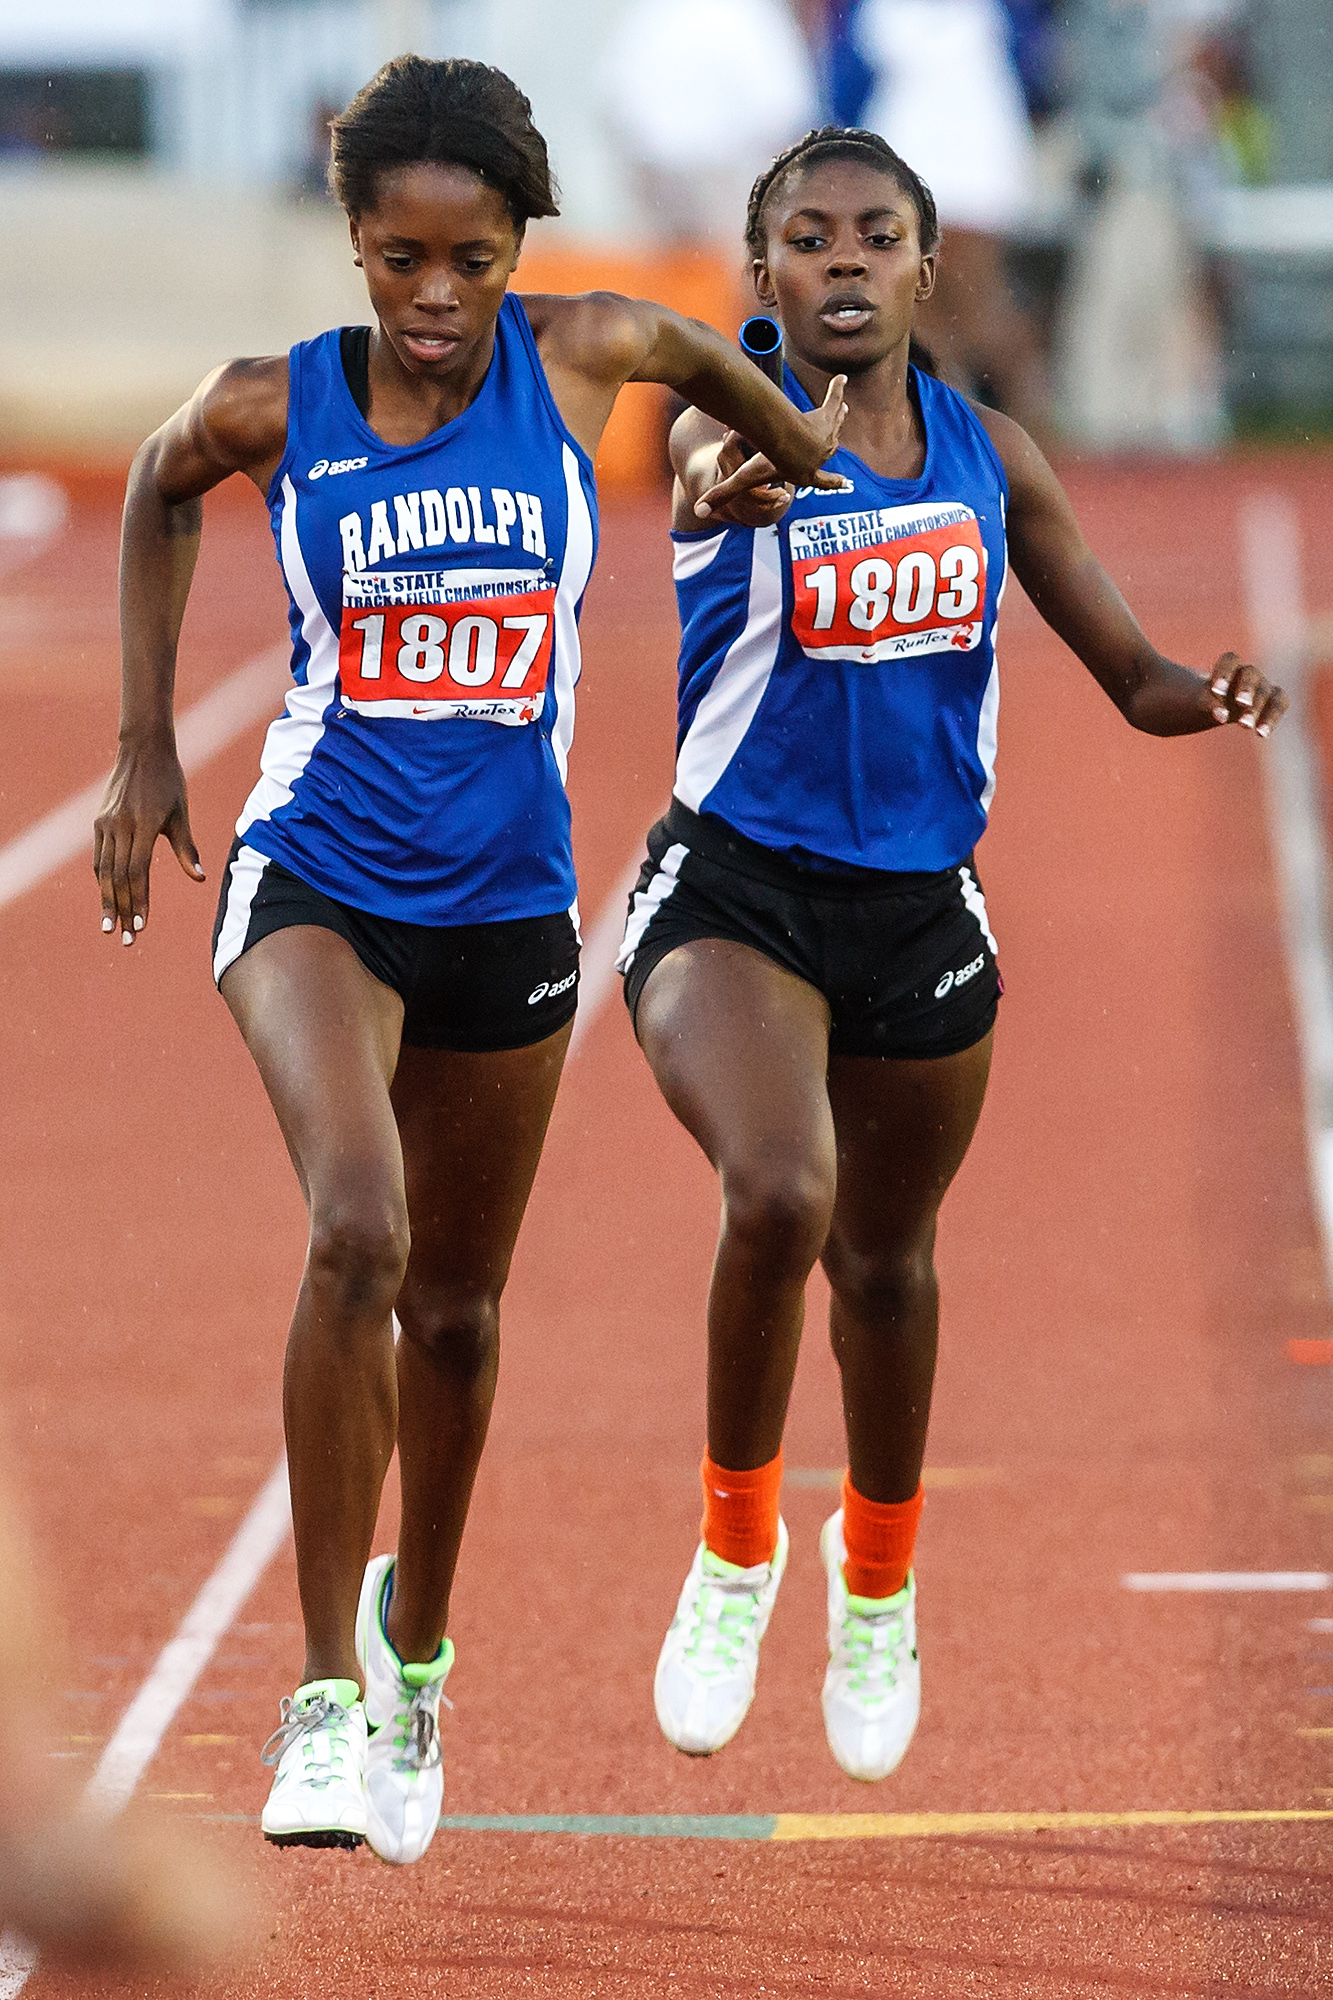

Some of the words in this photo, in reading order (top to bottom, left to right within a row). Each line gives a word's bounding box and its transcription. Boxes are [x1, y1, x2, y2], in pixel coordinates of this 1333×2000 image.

[327, 457, 369, 476] asics
[339, 486, 547, 572] RANDOLPH
[794, 540, 840, 560] TRACK
[841, 539, 851, 553] &
[852, 530, 884, 552] FIELD
[885, 508, 971, 543] CHAMPIONSHIPS
[838, 510, 884, 536] STATE
[393, 571, 445, 592] STATE
[805, 545, 979, 633] 1803
[345, 594, 393, 608] TRACK
[406, 588, 442, 605] FIELD
[352, 613, 549, 689] 1807
[891, 631, 949, 653] RunTex
[450, 703, 517, 718] RunTex
